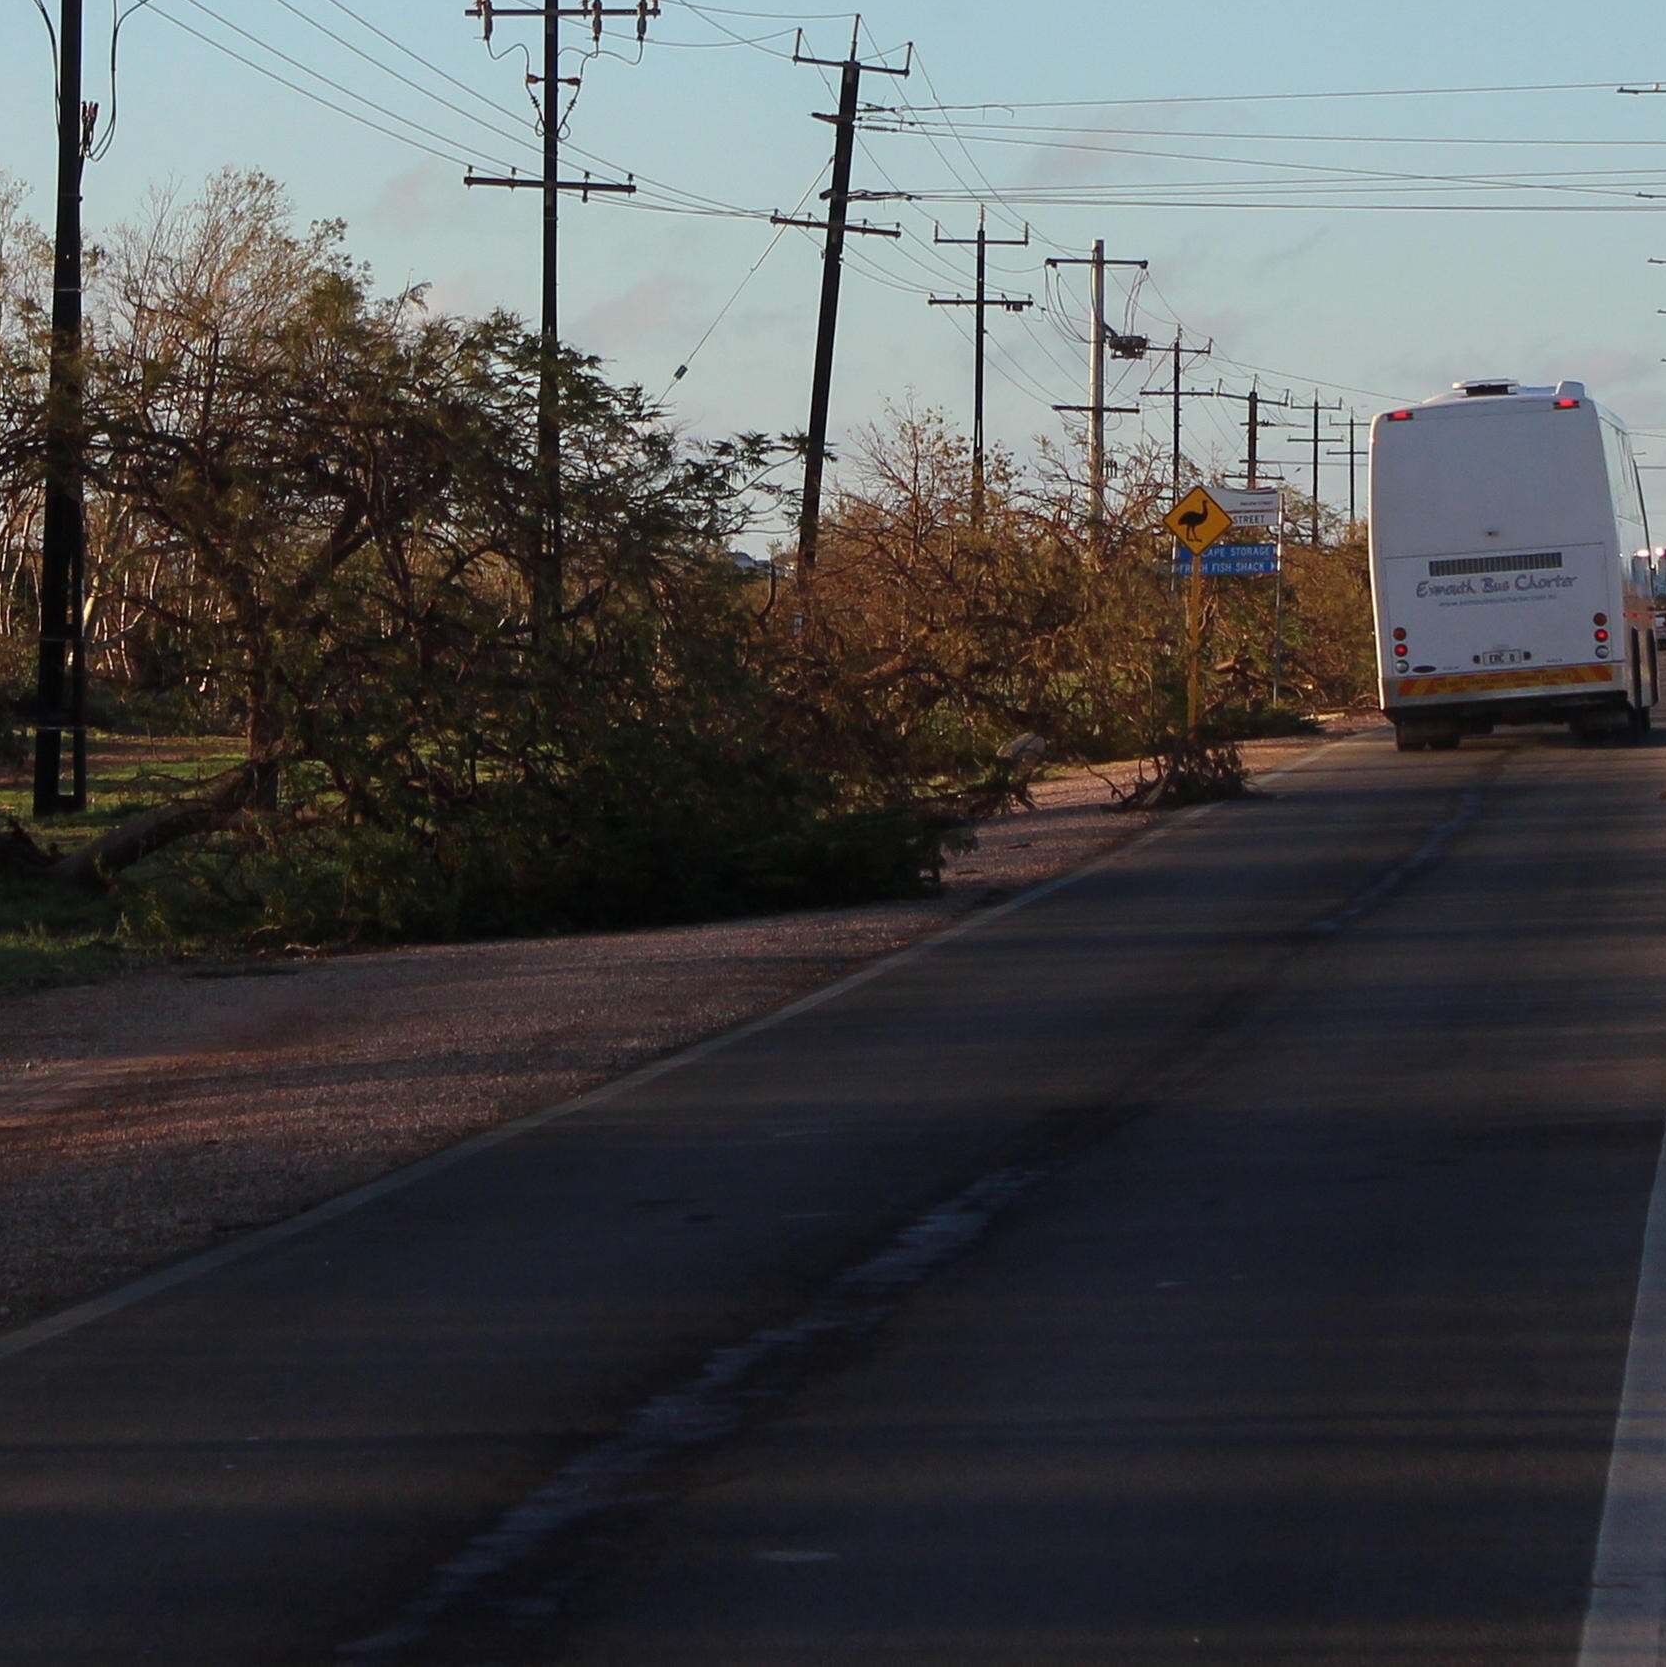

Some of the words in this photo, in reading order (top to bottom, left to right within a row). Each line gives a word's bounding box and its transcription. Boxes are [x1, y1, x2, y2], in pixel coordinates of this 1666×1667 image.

[1233, 515, 1265, 524] STREET
[1230, 546, 1270, 557] STORAGE
[1179, 562, 1208, 574] FRH
[1212, 562, 1232, 573] FISH
[1235, 561, 1265, 572] SHACK
[1416, 579, 1476, 598] Exmouth
[1481, 577, 1510, 593] Bus
[1515, 574, 1578, 591] Charter
